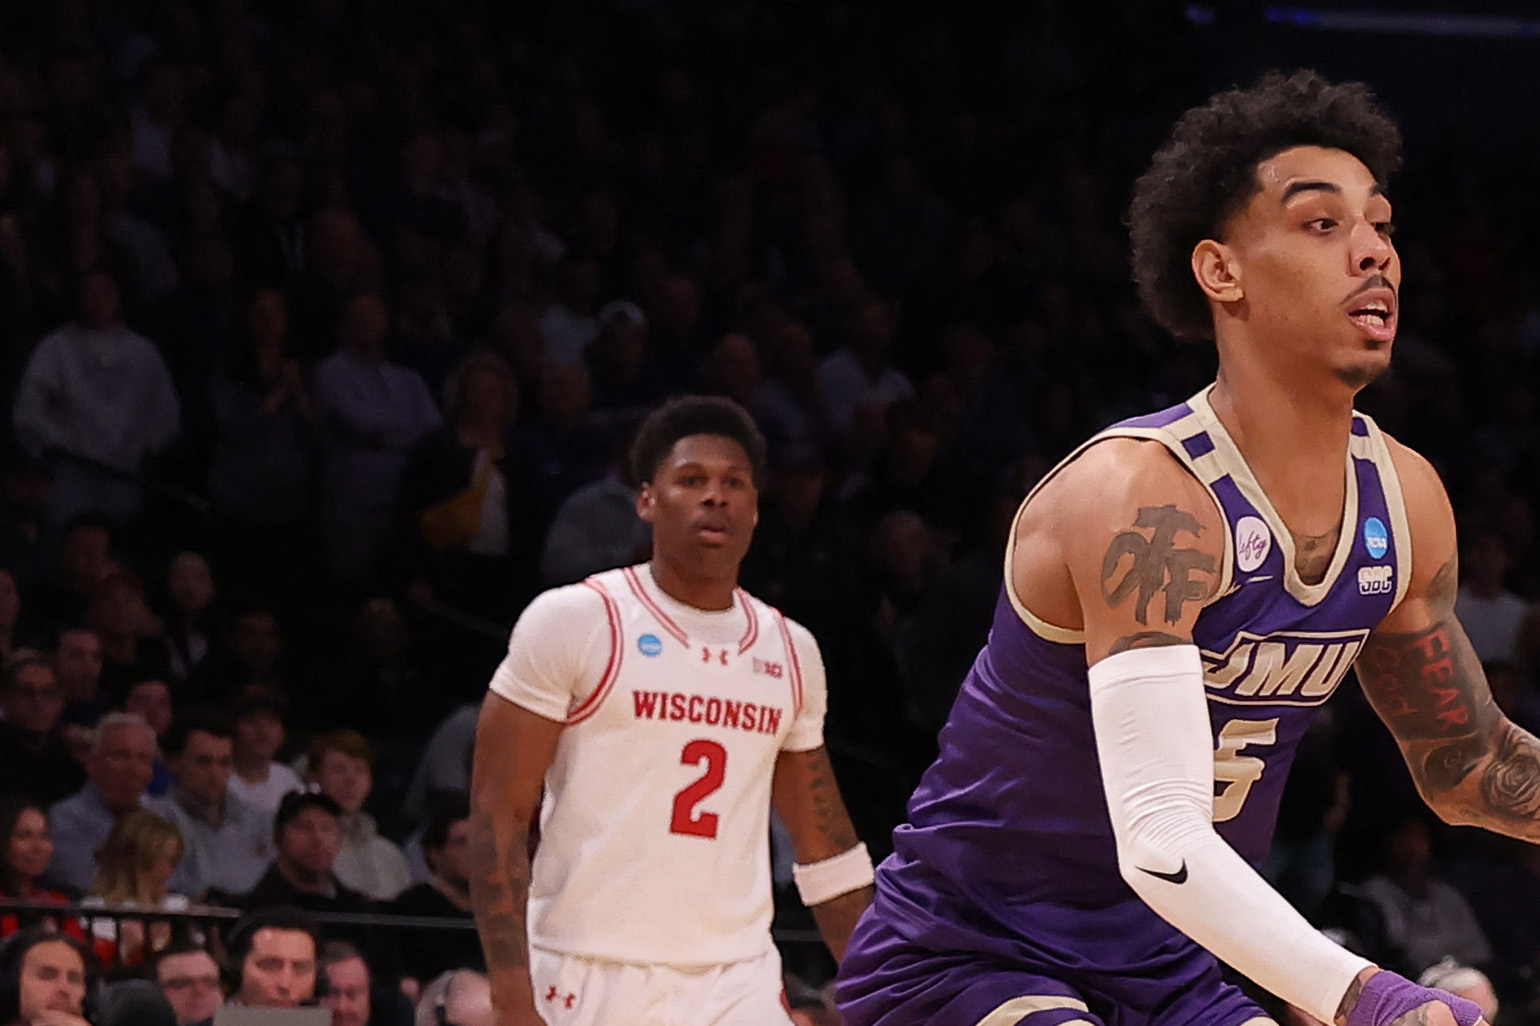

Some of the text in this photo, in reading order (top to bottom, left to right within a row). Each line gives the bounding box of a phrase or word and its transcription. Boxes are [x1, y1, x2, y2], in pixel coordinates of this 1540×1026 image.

[632, 690, 783, 737] WISCONSIN
[1201, 641, 1361, 698] JMU
[1404, 626, 1469, 732] FEAR
[669, 738, 728, 840] 2
[1213, 717, 1280, 823] 5
